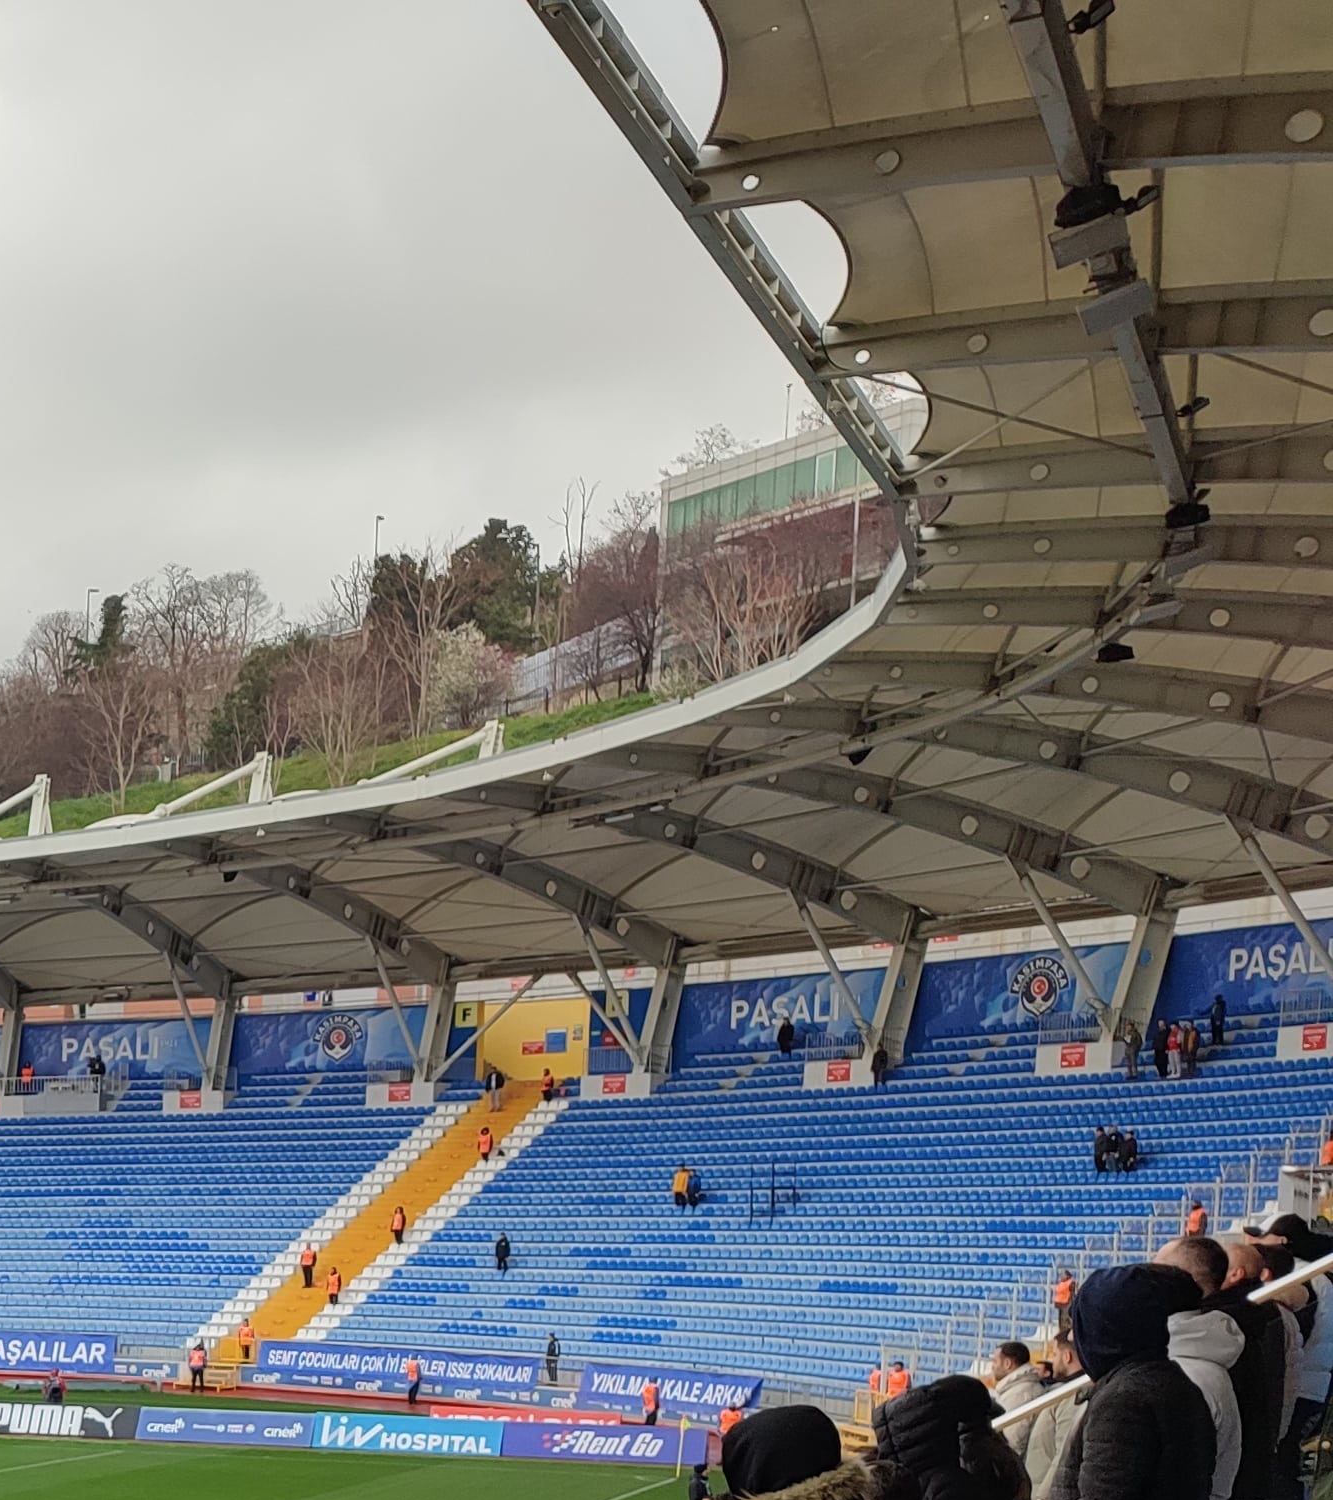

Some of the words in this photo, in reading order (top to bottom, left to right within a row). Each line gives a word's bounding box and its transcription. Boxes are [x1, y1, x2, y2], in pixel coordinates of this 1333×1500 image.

[463, 1007, 472, 1021] F
[268, 1349, 298, 1366] SEMT
[298, 1351, 361, 1370] ÇOCUKLARI
[474, 1364, 532, 1383] SOKAKLARI
[380, 1434, 491, 1454] HOSPITAL
[574, 1430, 625, 1457] Rent
[633, 1432, 664, 1457] Go
